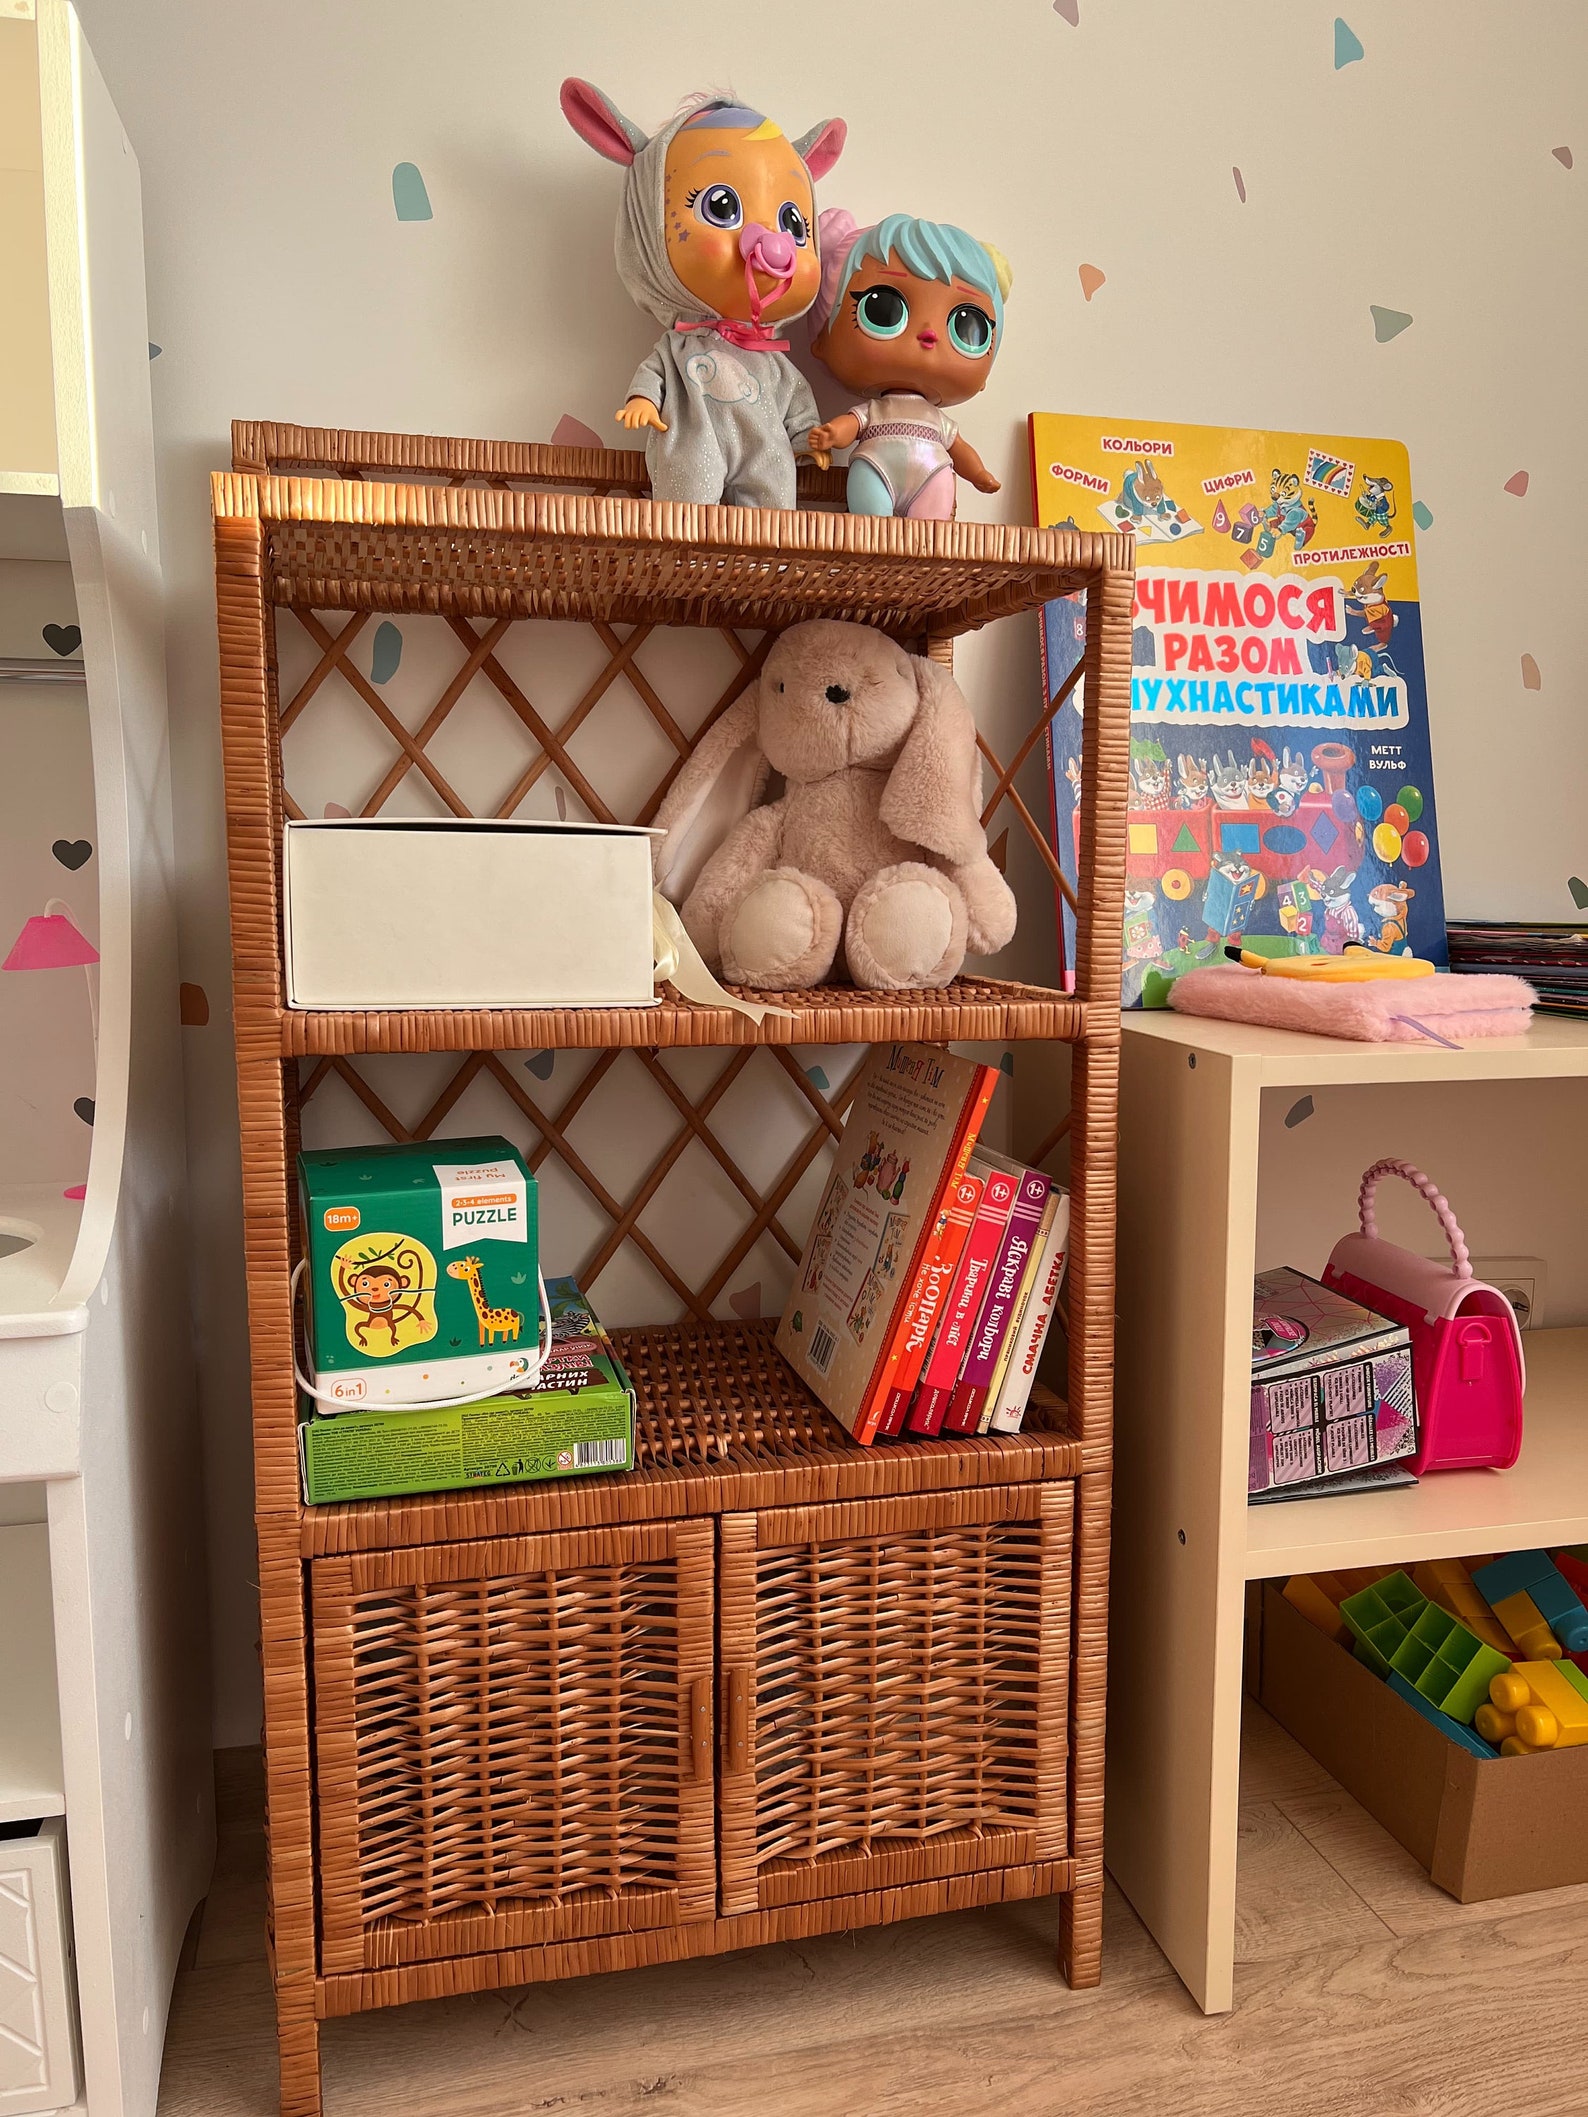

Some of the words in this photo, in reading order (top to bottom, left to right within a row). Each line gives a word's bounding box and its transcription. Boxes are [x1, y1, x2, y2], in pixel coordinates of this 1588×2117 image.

[1103, 438, 1172, 455] КОЛЬОРИ
[1051, 464, 1109, 493] ФОРМИ
[1203, 471, 1254, 493] ЦИФРИ
[1215, 512, 1225, 527] 9
[1250, 511, 1259, 525] 6
[1235, 528, 1245, 540] 7
[1259, 538, 1268, 551] 5
[1293, 543, 1410, 565] ПРОТИЛЕЖНОСТІ
[1132, 578, 1336, 633] ЧИМОСЯ
[1076, 623, 1084, 636] 8
[1163, 632, 1303, 675] РАЗОМ
[1371, 745, 1402, 755] МЕТТ
[1369, 760, 1407, 770] ВУЛЬФ
[1282, 895, 1292, 906] 4
[1298, 891, 1306, 906] 3
[1297, 917, 1307, 932] 2
[1299, 941, 1306, 954] 1
[456, 1167, 499, 1175] puzzle
[959, 1187, 974, 1200] 1+
[993, 1185, 1008, 1198] 1+
[1028, 1182, 1043, 1196] 1+
[477, 1196, 512, 1205] elements
[327, 1214, 358, 1225] 18m+
[452, 1207, 517, 1227] PUZZLE
[920, 1262, 931, 1276] Не
[995, 1235, 1028, 1299] Яскраві
[912, 1277, 925, 1300] хоче
[958, 1257, 988, 1308] Тварини
[903, 1301, 917, 1324] їсти
[955, 1311, 965, 1319] в
[1022, 1313, 1048, 1375] СМАЧНА
[1042, 1251, 1066, 1306] АБЕТКА
[946, 1321, 961, 1347] лісі
[976, 1304, 1005, 1361] кольори
[540, 1370, 589, 1381] АРНИХ
[335, 1384, 344, 1398] 6
[345, 1387, 355, 1396] in
[356, 1382, 362, 1395] 1
[531, 1379, 588, 1391] АСТИН
